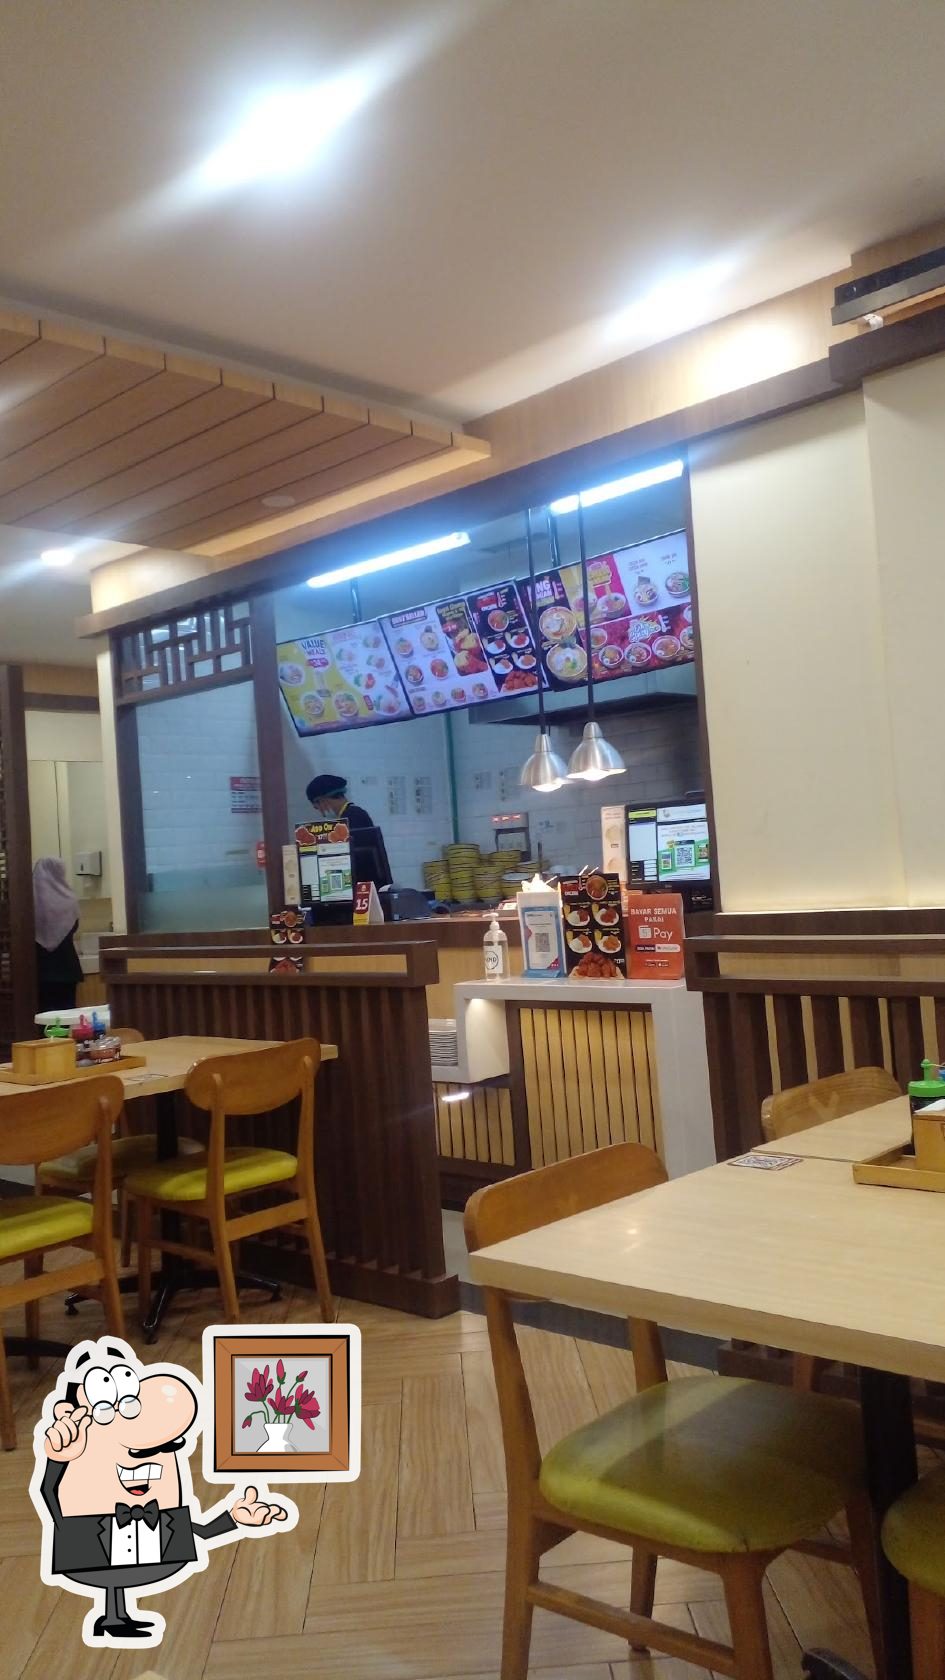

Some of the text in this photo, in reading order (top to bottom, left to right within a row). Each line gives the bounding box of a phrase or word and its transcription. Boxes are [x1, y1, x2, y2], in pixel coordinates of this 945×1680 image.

[301, 639, 325, 649] VALUE
[355, 898, 369, 911] 15
[630, 907, 678, 916] BAYAR SEMUA
[653, 927, 673, 942] Pay
